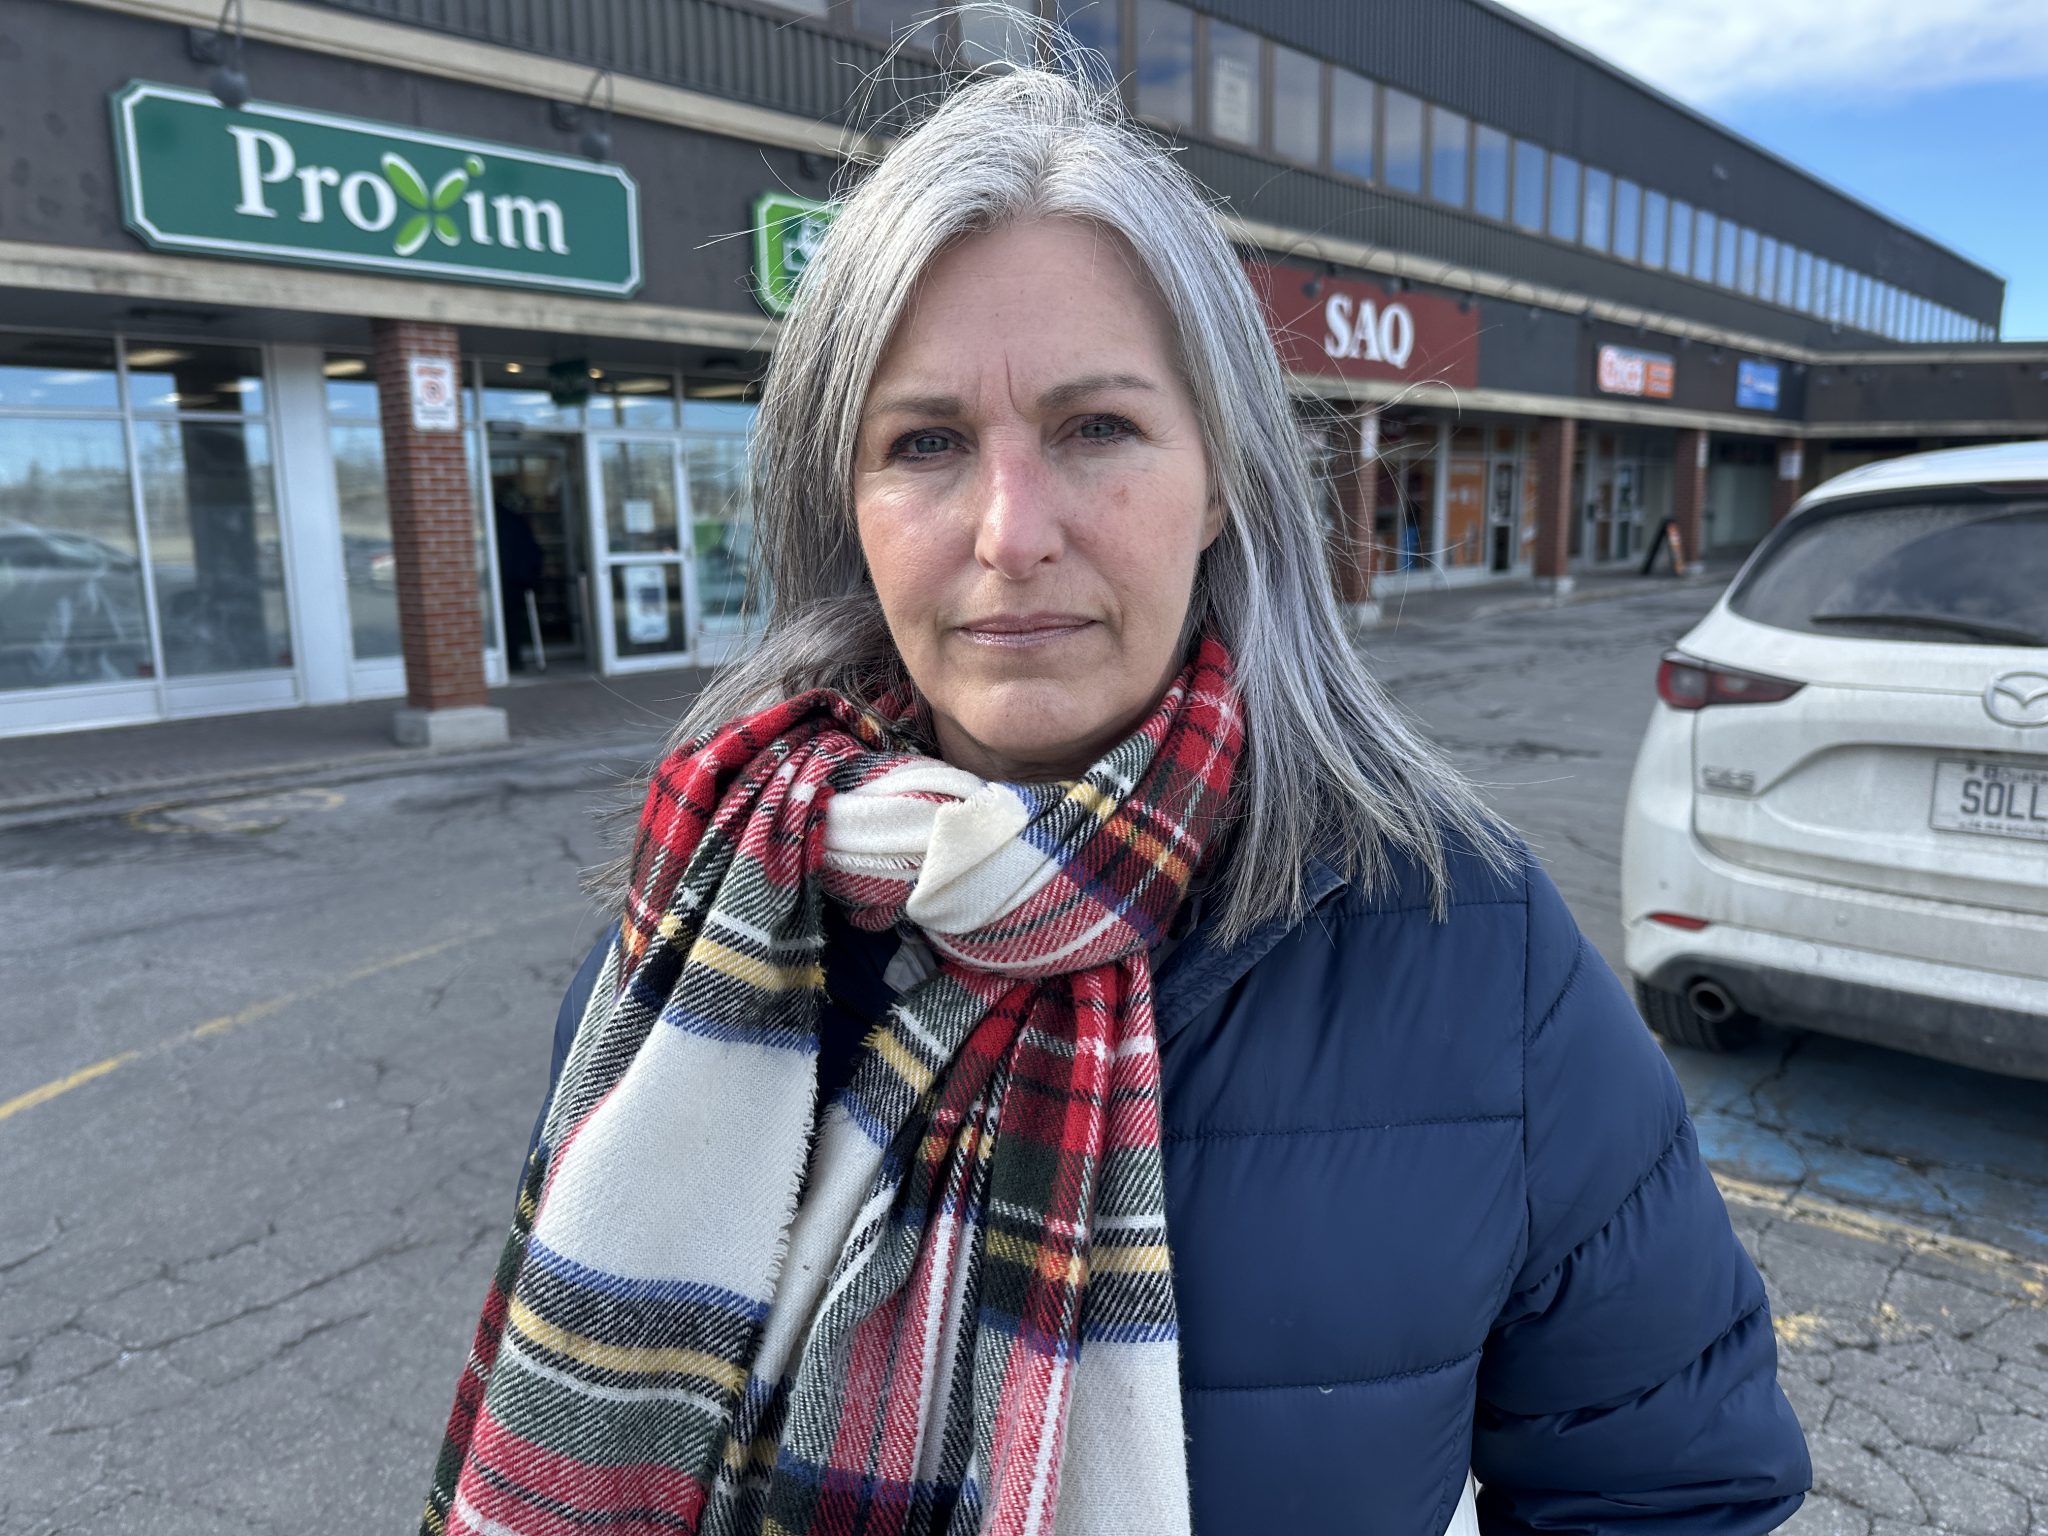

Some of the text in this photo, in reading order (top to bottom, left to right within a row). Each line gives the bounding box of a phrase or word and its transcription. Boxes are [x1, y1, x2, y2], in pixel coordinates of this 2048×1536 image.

[226, 124, 570, 256] Proxim
[1324, 292, 1416, 370] SAQ
[1961, 778, 2048, 822] SOLL
